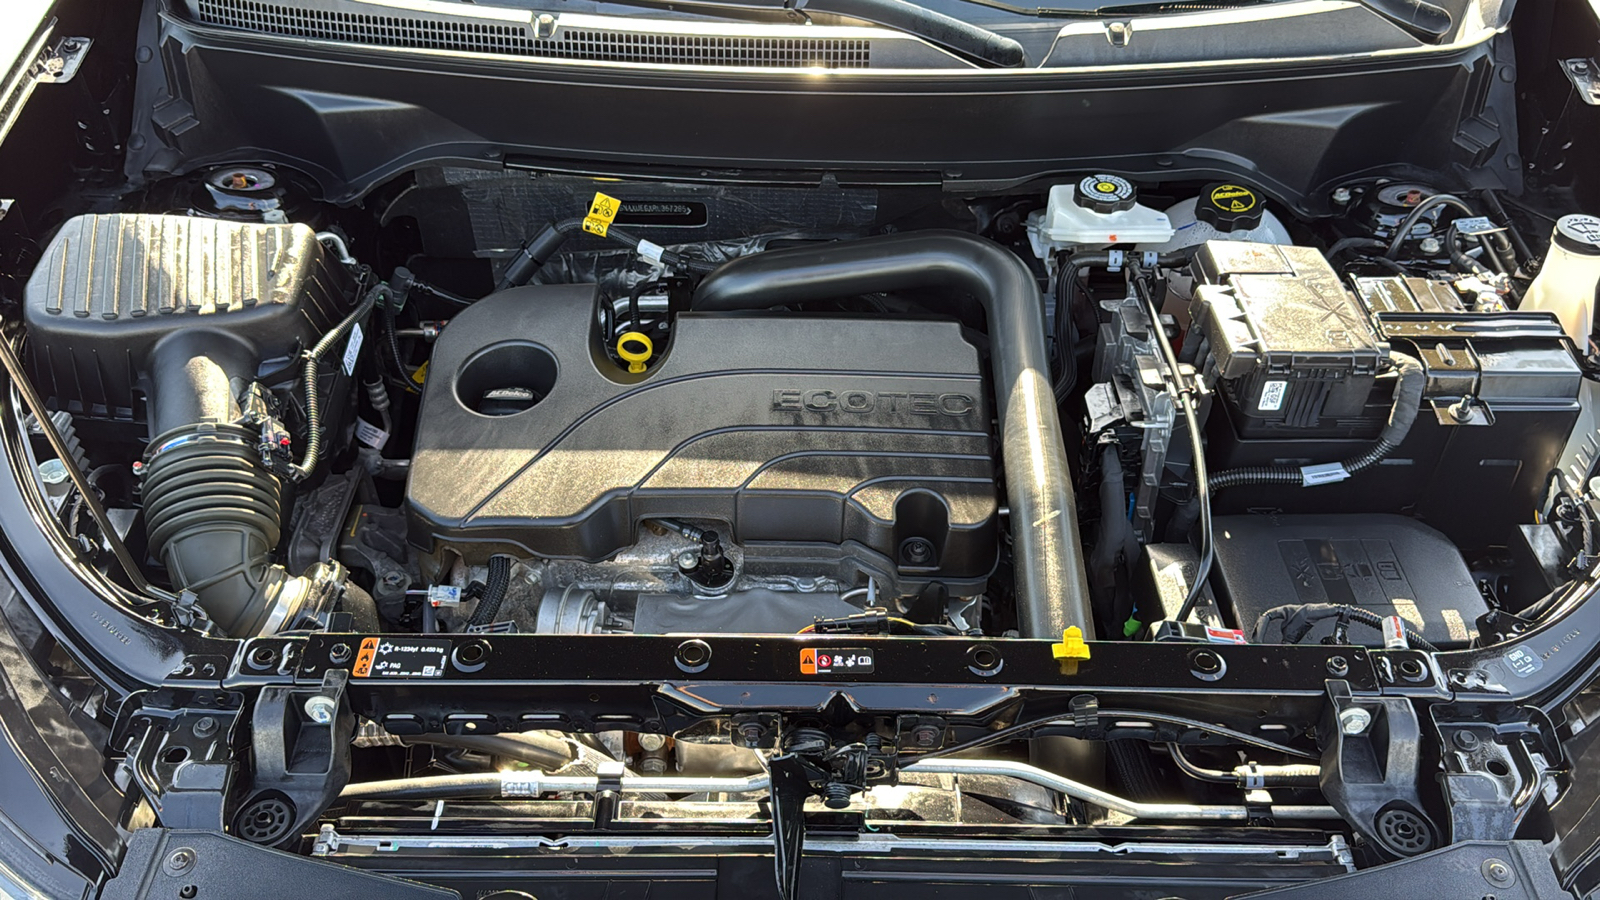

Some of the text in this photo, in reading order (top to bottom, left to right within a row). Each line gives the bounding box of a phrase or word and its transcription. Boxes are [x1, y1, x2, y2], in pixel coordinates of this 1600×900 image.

[485, 390, 530, 398] ACDelco
[772, 388, 974, 417] ECOTEC
[1508, 649, 1525, 662] GND
